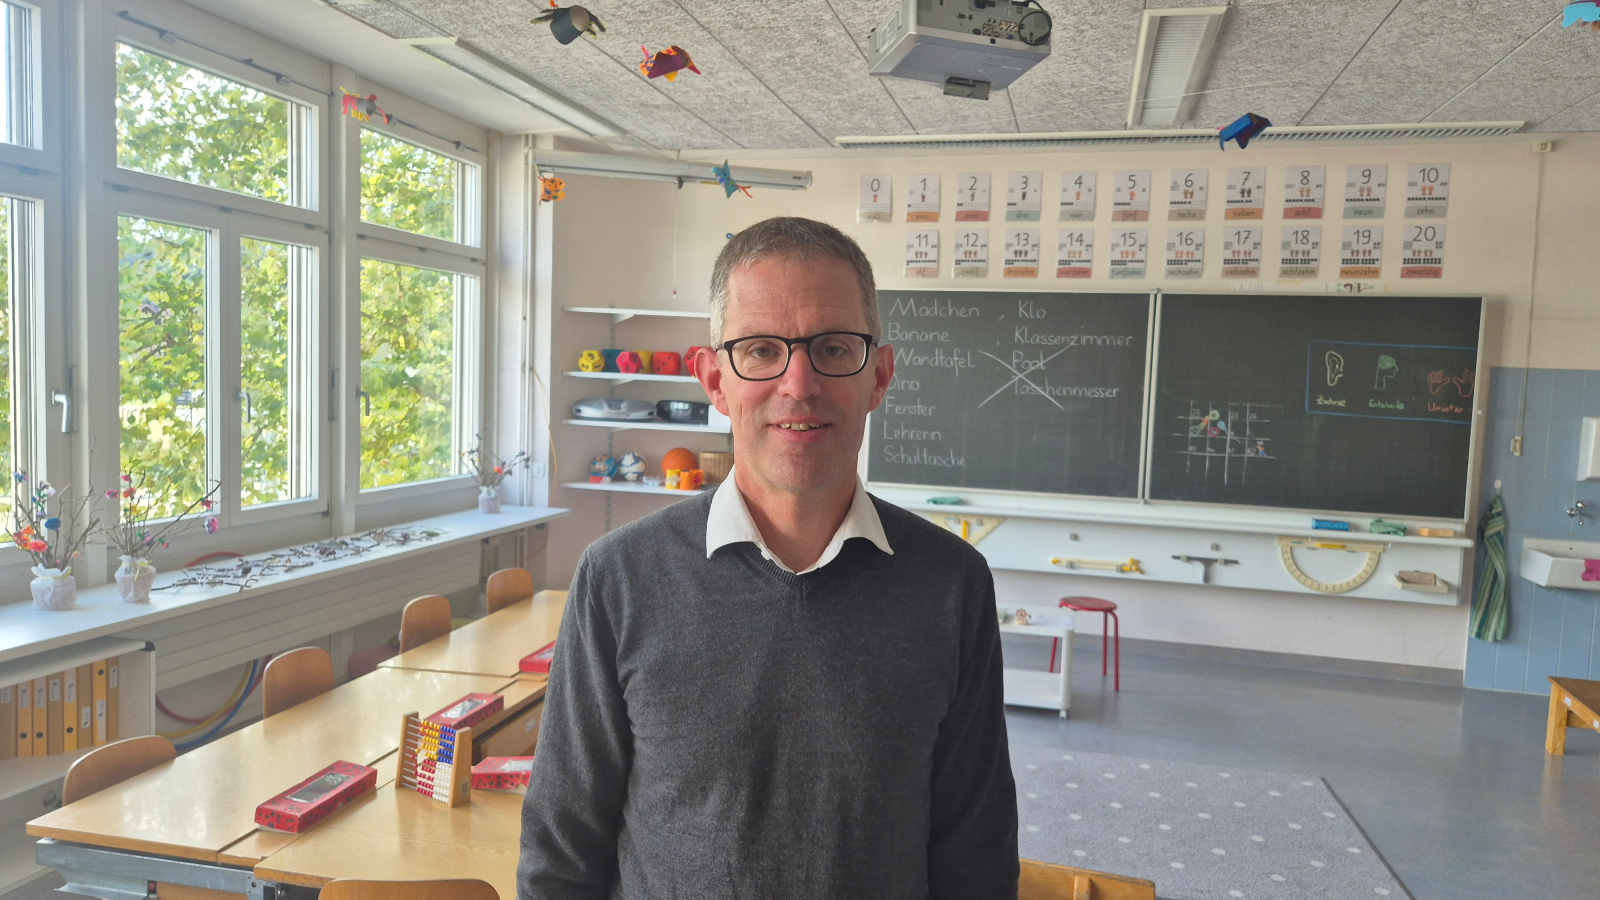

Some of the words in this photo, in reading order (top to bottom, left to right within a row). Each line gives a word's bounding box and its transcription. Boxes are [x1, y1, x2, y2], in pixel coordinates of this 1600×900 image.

[968, 176, 978, 191] 2
[1020, 175, 1029, 190] 3
[1073, 174, 1083, 190] 4
[1127, 174, 1137, 190] 5
[1184, 173, 1194, 188] 6
[1241, 171, 1251, 187] 7
[1300, 170, 1310, 186] 8
[1361, 168, 1372, 185] 9
[1418, 167, 1439, 184] 10
[869, 178, 880, 192] 0
[920, 177, 927, 192] 1
[915, 233, 929, 248] 11
[963, 232, 979, 247] 12
[1014, 232, 1030, 247] 13
[1066, 232, 1084, 247] 14
[1120, 232, 1137, 247] 15
[1176, 231, 1194, 247] 16
[1234, 230, 1252, 246] 17
[1291, 229, 1310, 245] 18
[1352, 229, 1372, 245] 19
[1412, 226, 1436, 242] 20
[889, 297, 980, 318] Mädchen
[1018, 299, 1047, 319] Klo
[887, 322, 951, 343] Banane
[1014, 325, 1134, 346] Klassenzimmer
[1011, 375, 1121, 398] Taschenmesser
[885, 396, 936, 417] Fenster
[883, 420, 942, 441] Lehrerin
[883, 444, 967, 467] Schultasche
